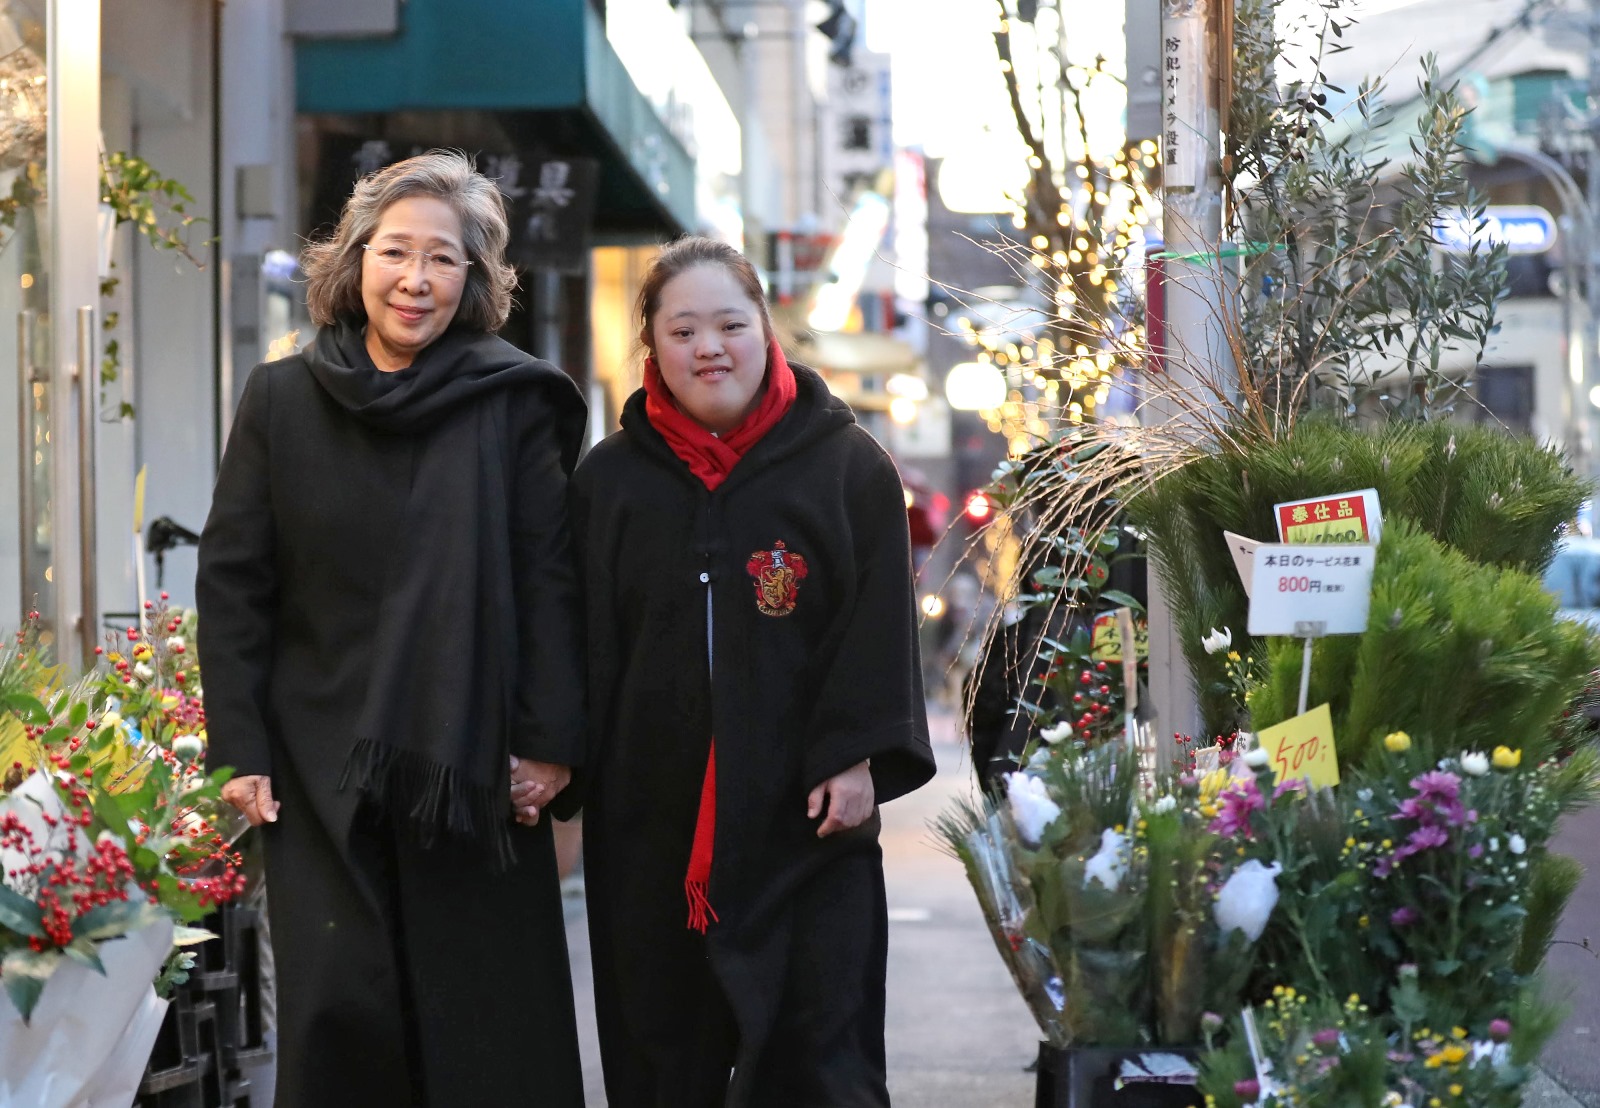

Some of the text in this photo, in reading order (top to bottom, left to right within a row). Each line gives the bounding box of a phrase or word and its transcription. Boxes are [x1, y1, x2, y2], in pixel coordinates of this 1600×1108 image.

[1165, 37, 1181, 165] 防犯カメラ設置
[1292, 500, 1353, 523] 奉仕品
